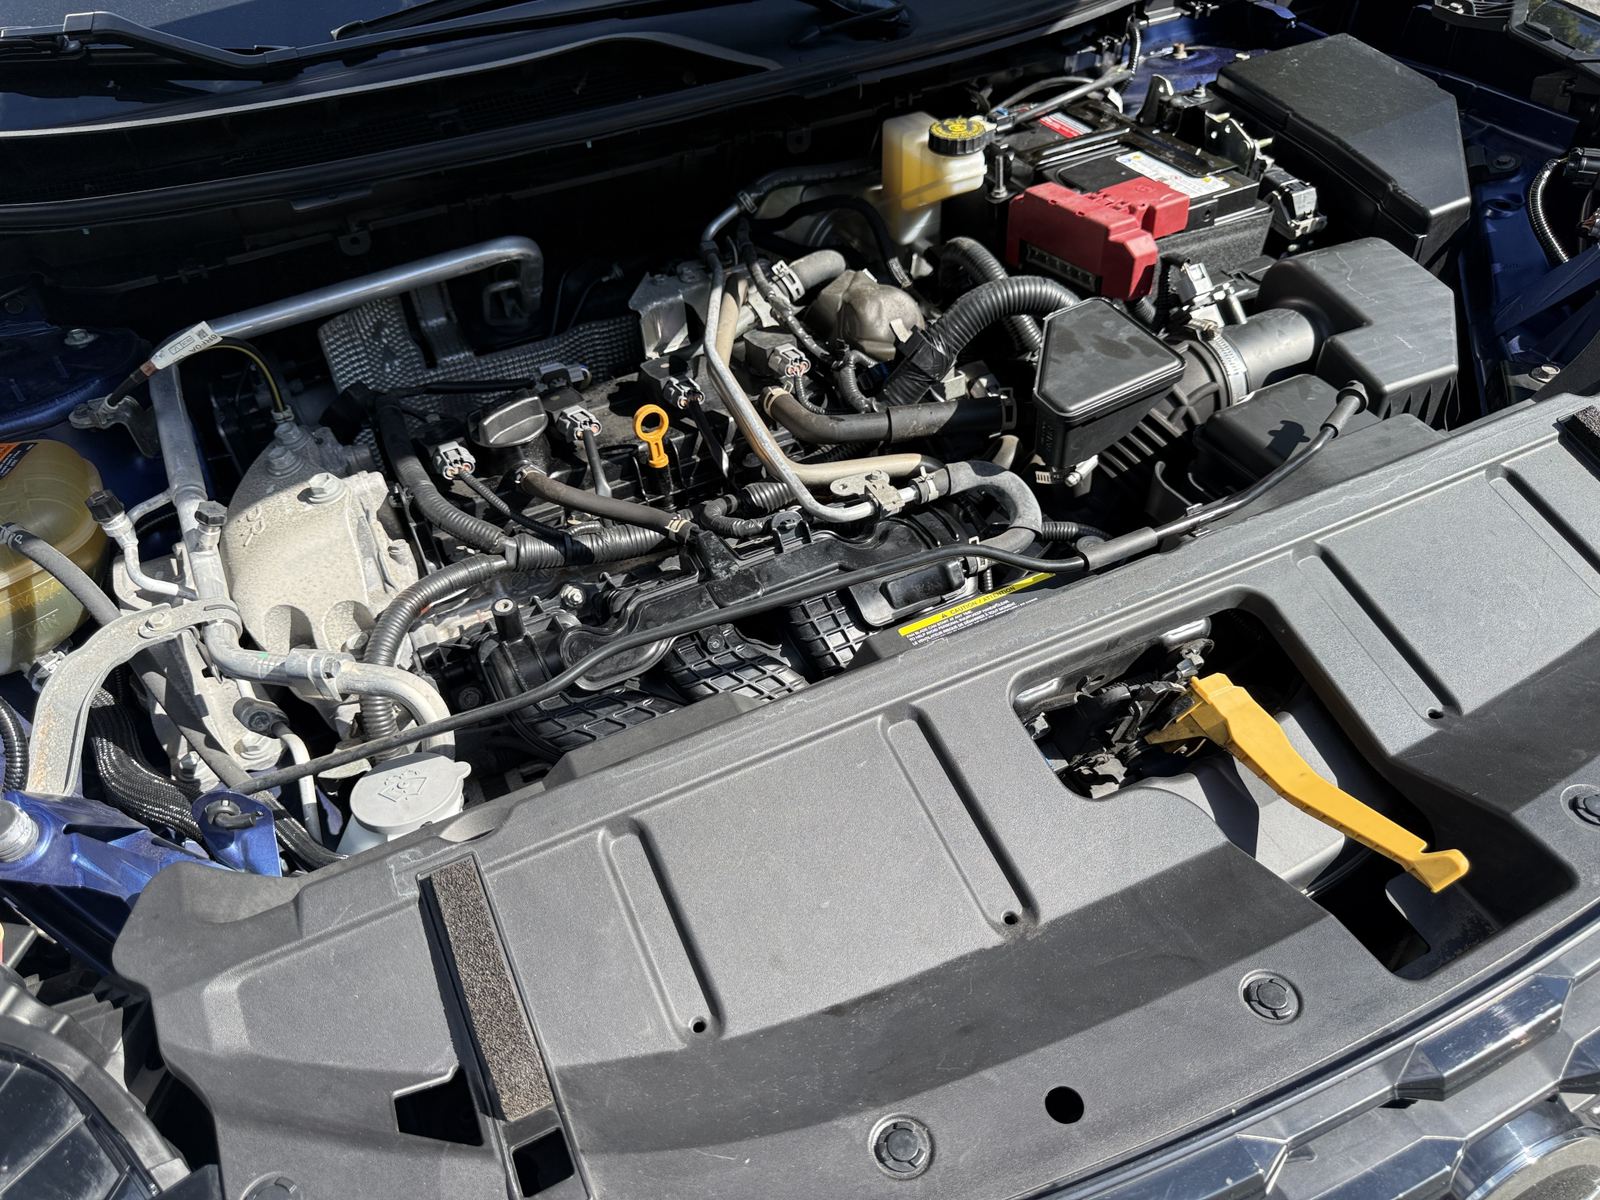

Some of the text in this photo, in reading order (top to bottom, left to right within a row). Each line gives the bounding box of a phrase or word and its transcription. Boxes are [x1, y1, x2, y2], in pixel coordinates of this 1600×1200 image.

[14, 534, 23, 545] P
[18, 582, 60, 612] MAX
[950, 601, 978, 614] CAUTION
[983, 586, 1016, 602] ATTENTION
[26, 614, 59, 638] MIN
